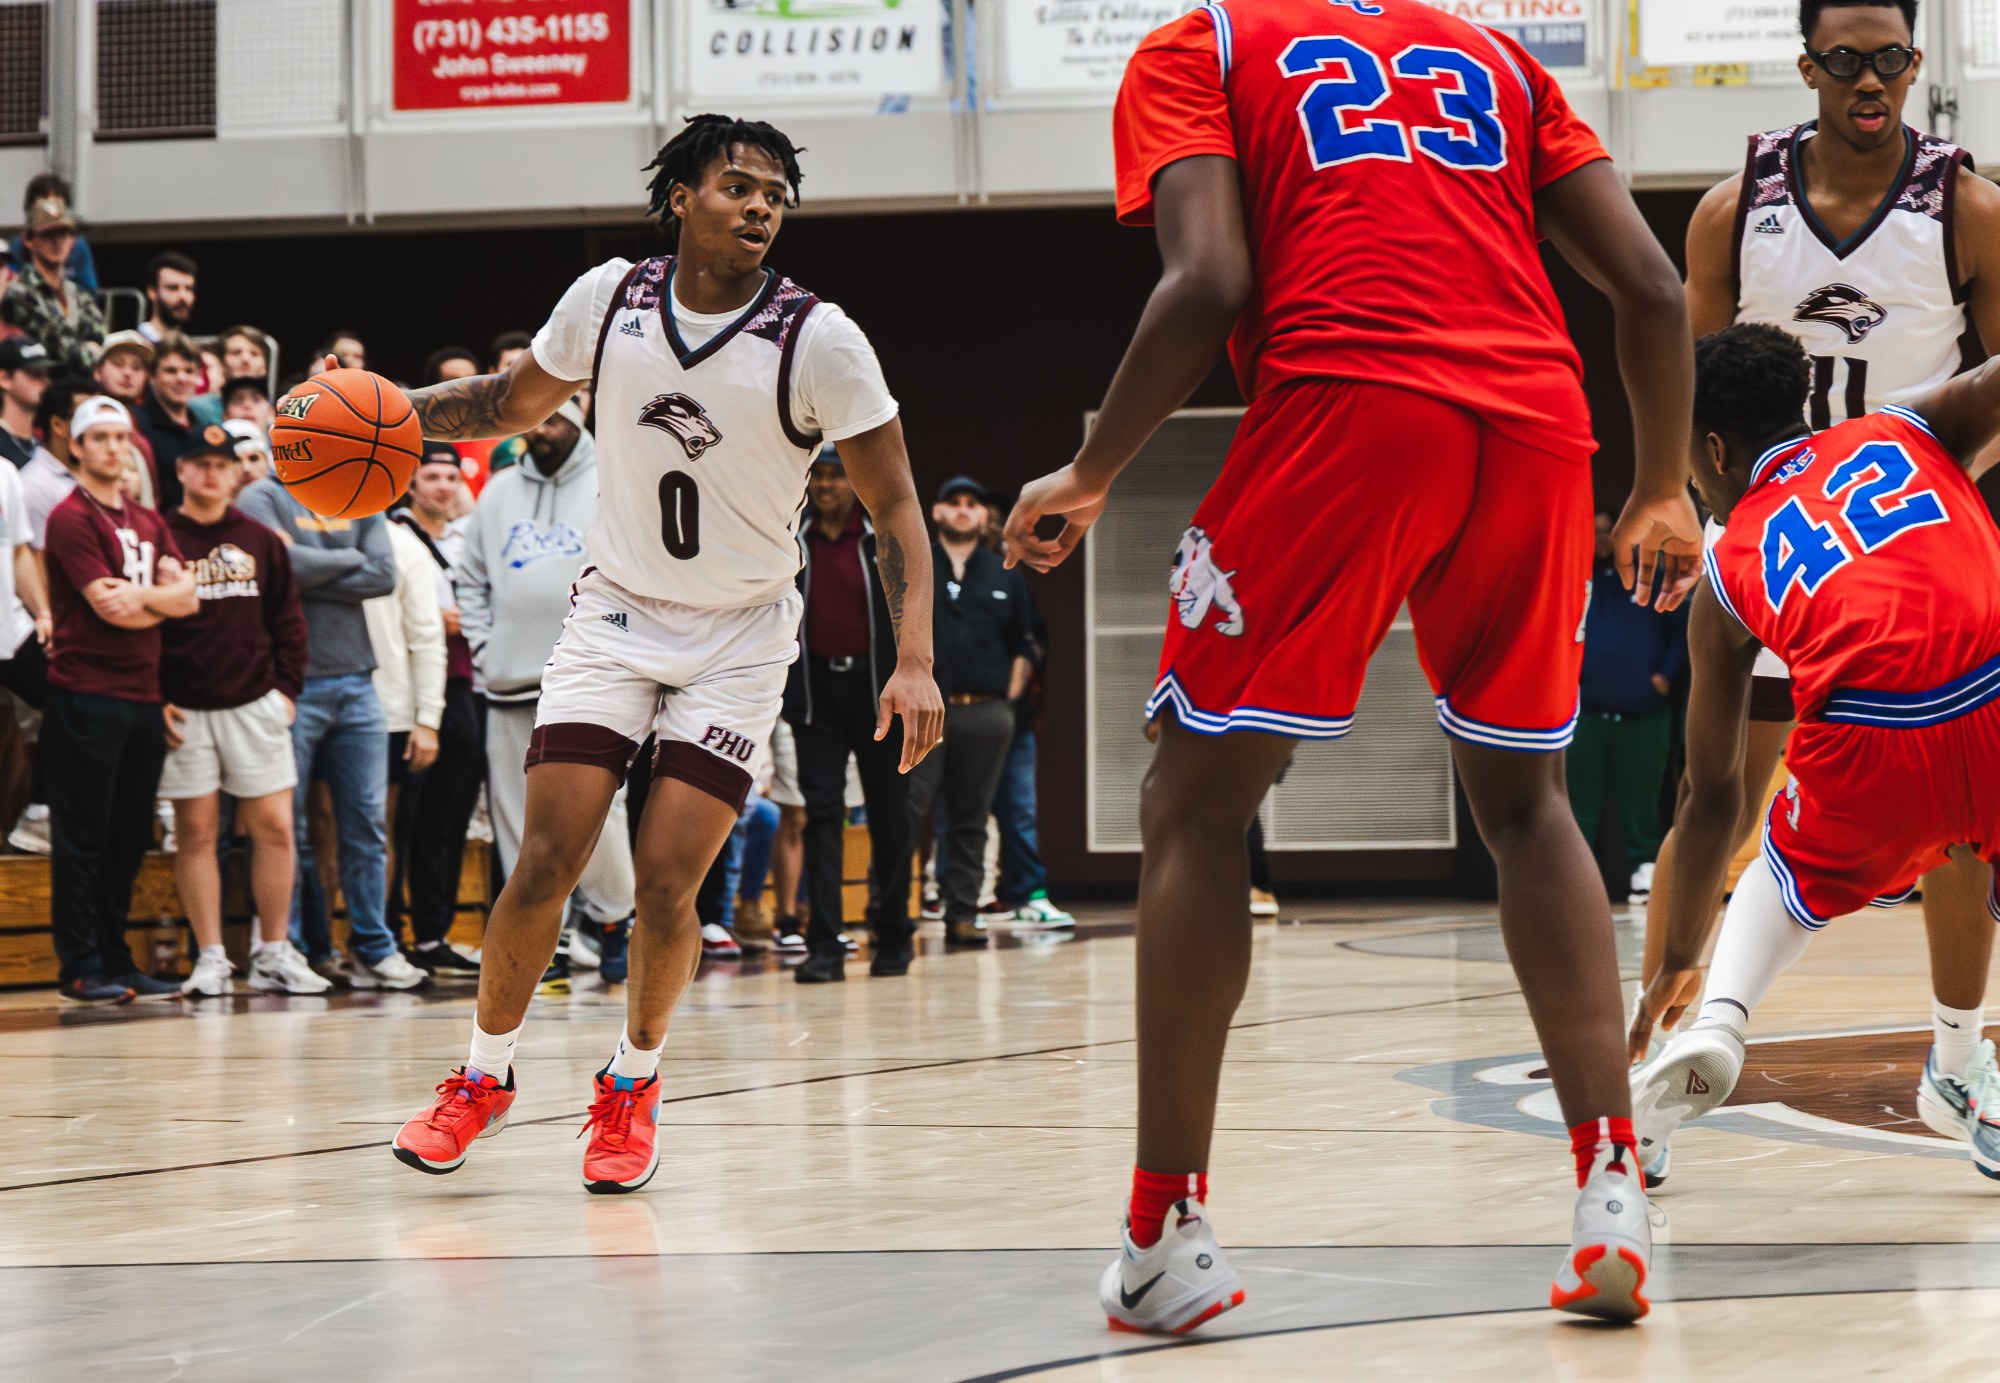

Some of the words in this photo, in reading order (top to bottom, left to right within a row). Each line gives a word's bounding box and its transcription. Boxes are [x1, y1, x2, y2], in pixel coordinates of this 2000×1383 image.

[413, 18, 482, 54] (731)
[710, 27, 916, 55] COLLISION
[1276, 35, 1508, 171] 23
[658, 470, 700, 561] 0
[1759, 440, 1951, 616] 42
[698, 725, 756, 762] FHU
